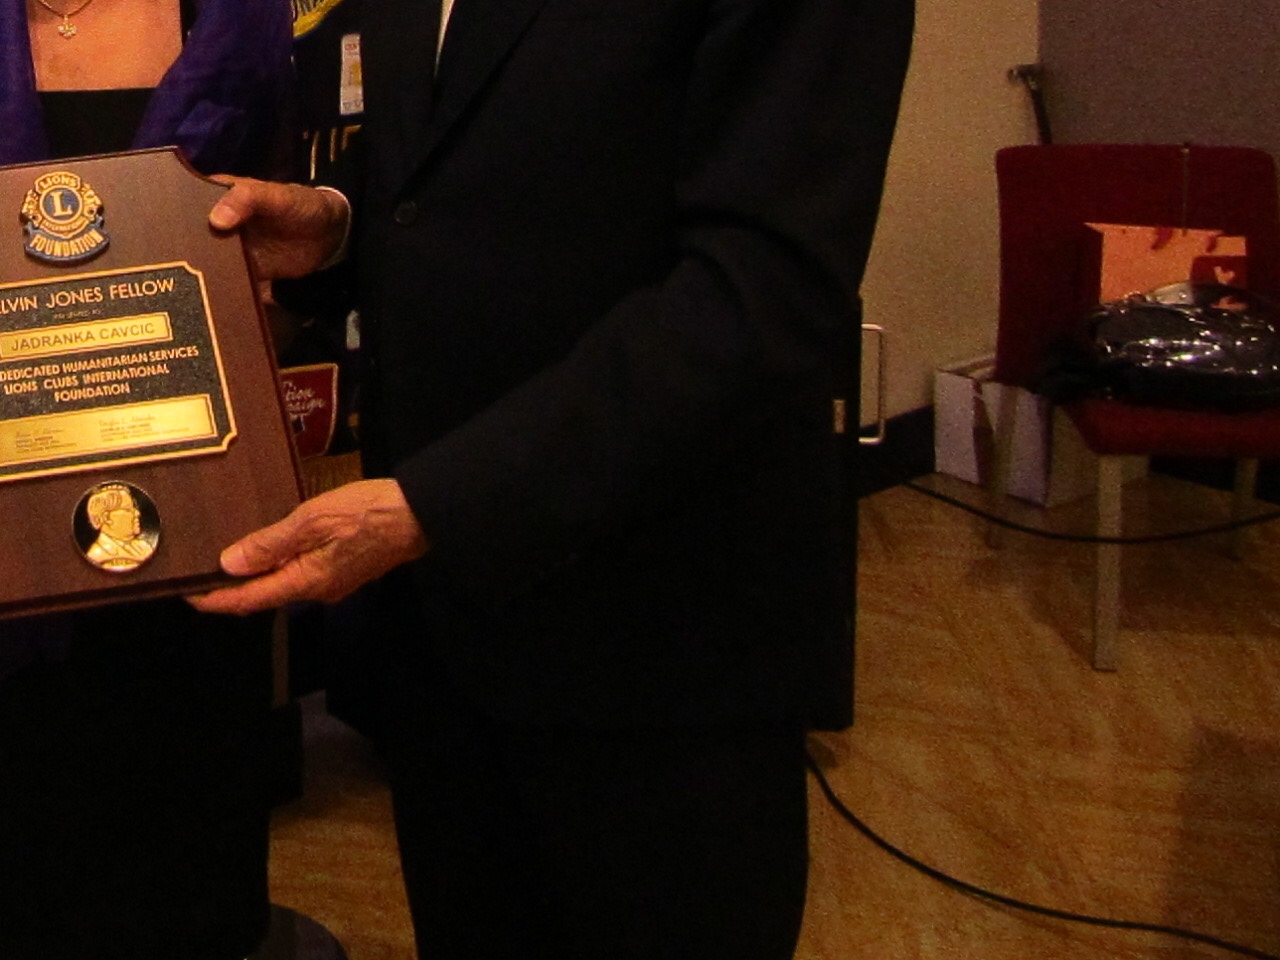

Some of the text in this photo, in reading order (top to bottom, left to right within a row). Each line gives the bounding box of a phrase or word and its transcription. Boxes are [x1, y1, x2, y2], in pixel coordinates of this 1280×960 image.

[39, 175, 77, 188] LIONS
[49, 191, 73, 217] L
[29, 228, 105, 257] FOUNDATION
[46, 287, 104, 309] JONES
[110, 277, 175, 300] FELLOW
[11, 322, 156, 352] JADRANKA CAVCIC
[62, 352, 149, 374] HUMANITARIAN
[149, 345, 200, 362] SERVICES
[3, 364, 170, 396] LIONS CLUBS INTERNATIONAL
[54, 384, 131, 403] FOUNDATION
